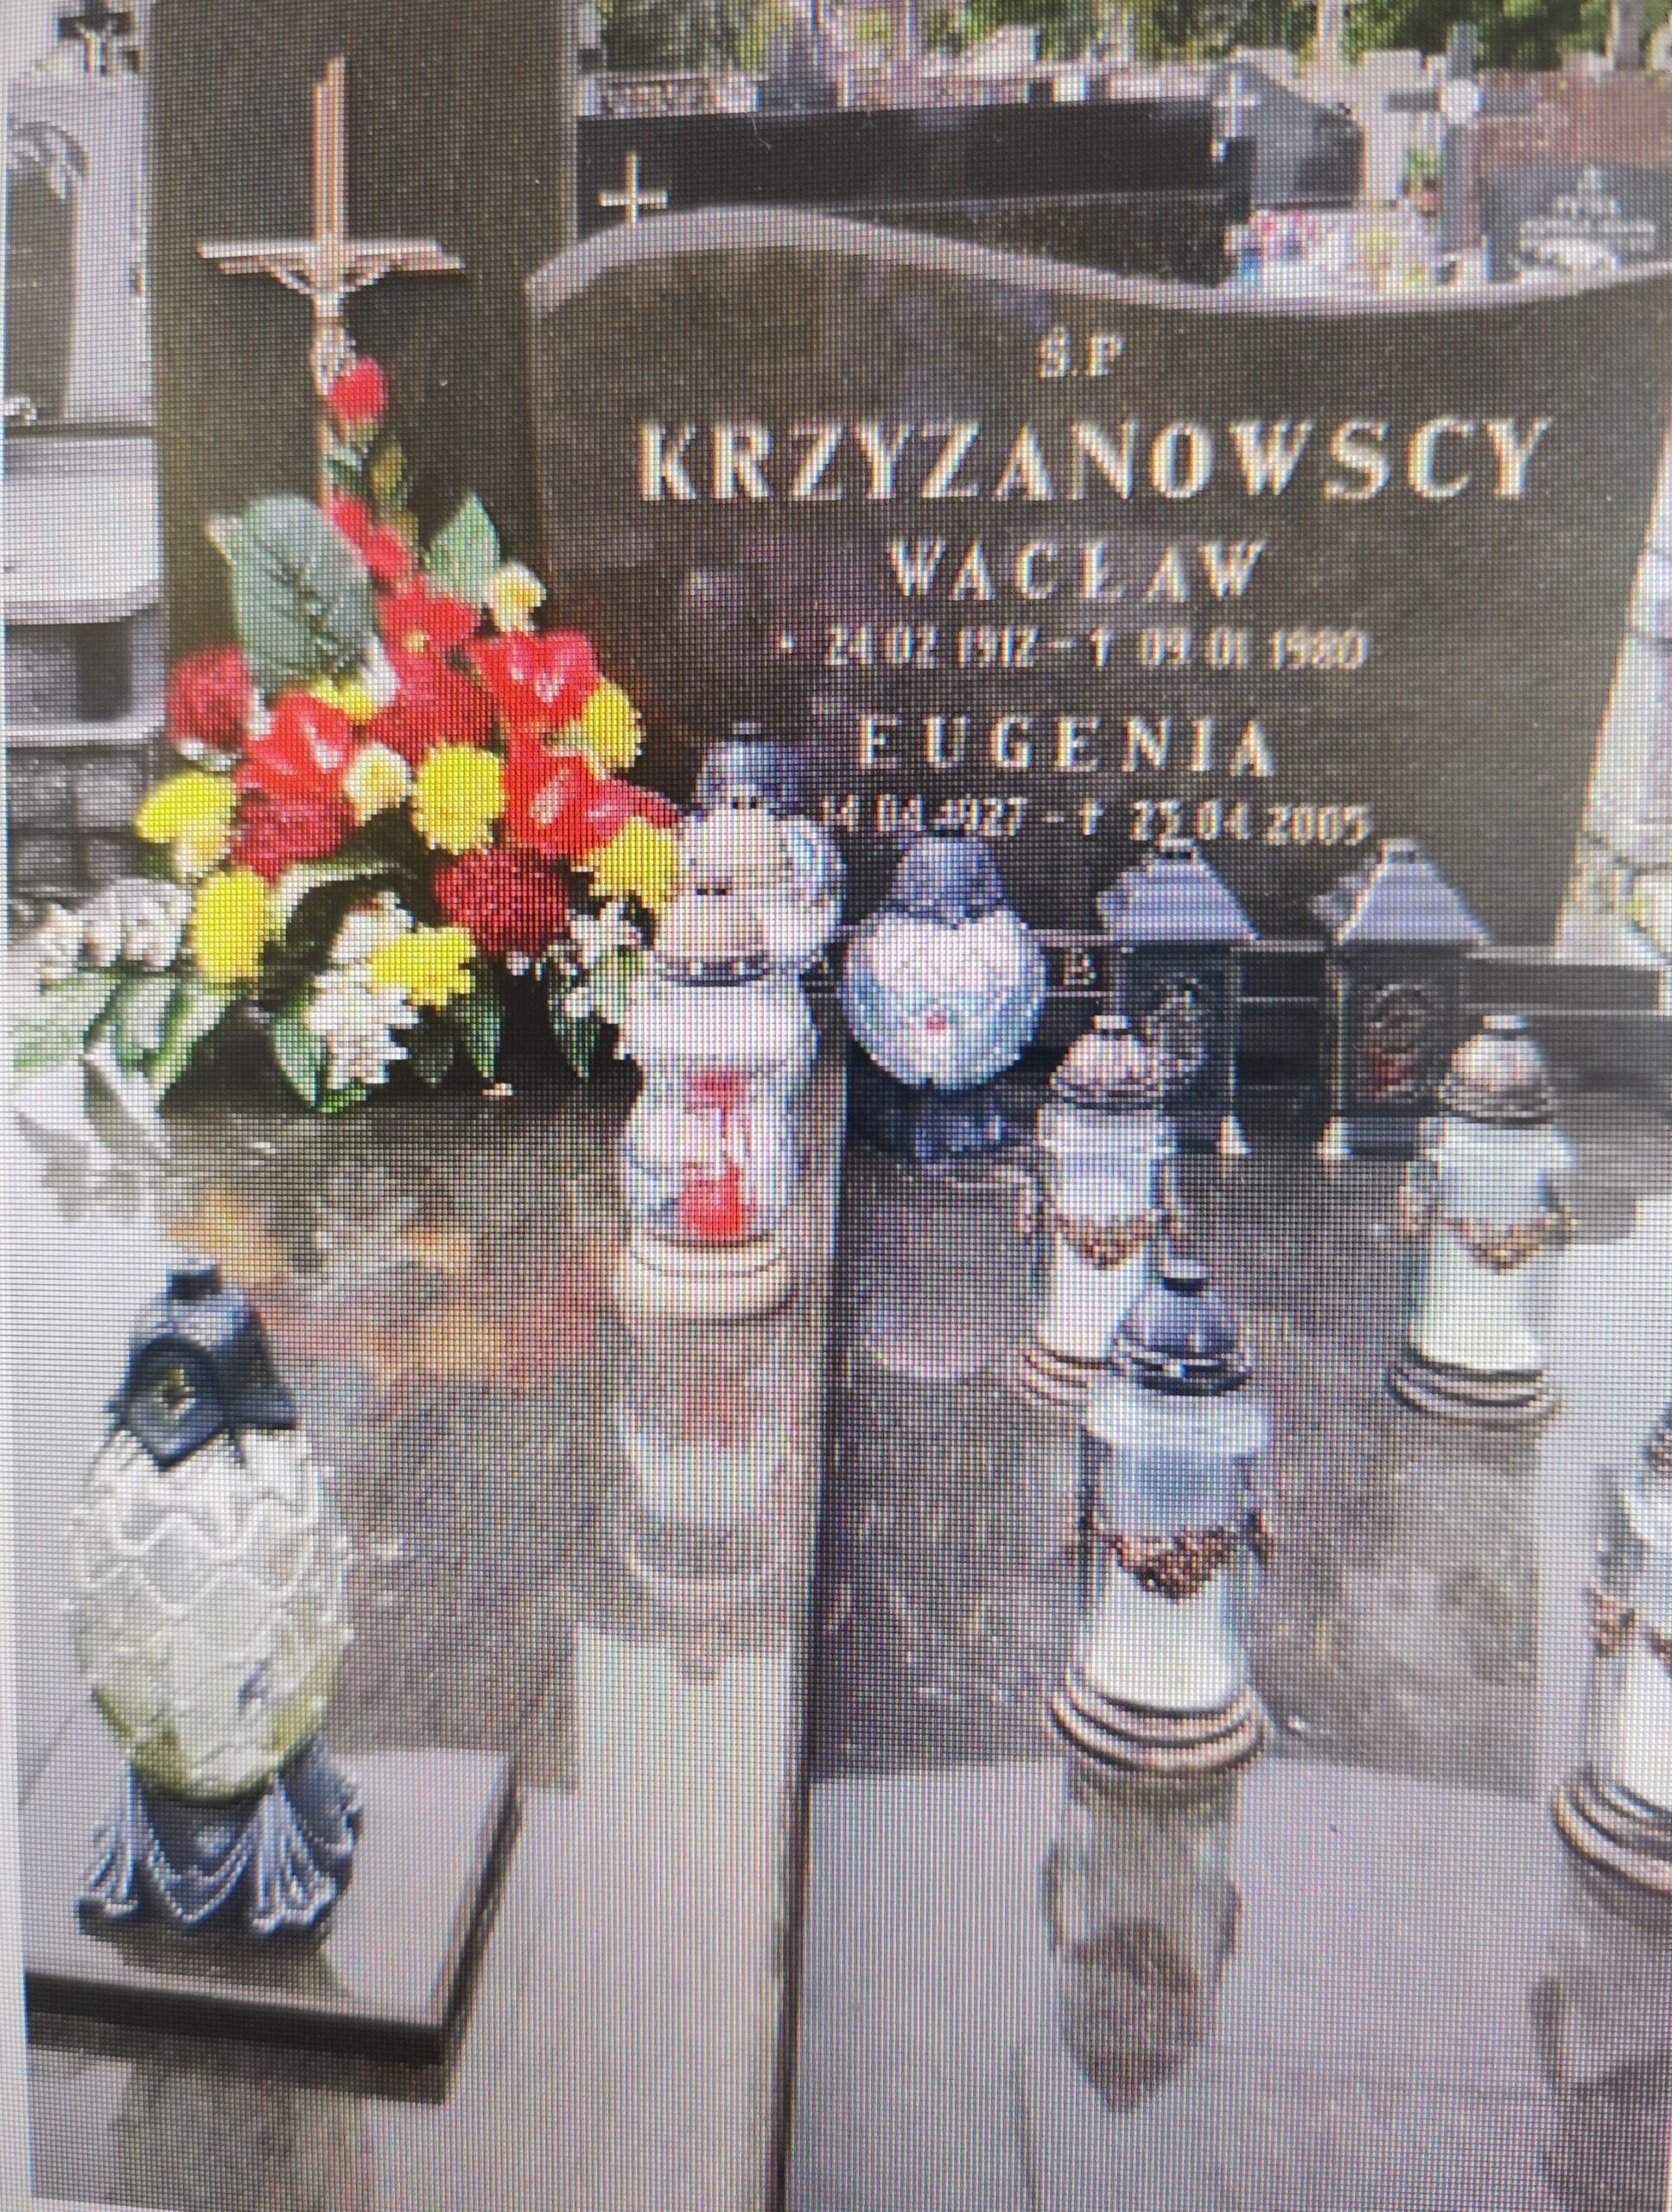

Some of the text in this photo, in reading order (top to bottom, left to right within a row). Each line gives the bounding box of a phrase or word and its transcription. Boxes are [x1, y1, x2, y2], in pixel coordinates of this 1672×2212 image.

[888, 538, 1266, 601] WACŁAW
[957, 626, 1037, 668] 1912
[1269, 628, 1370, 669] 1980
[860, 715, 1275, 777] EUGENIA
[1196, 799, 1249, 840] 04
[1265, 804, 1370, 846] 2005
